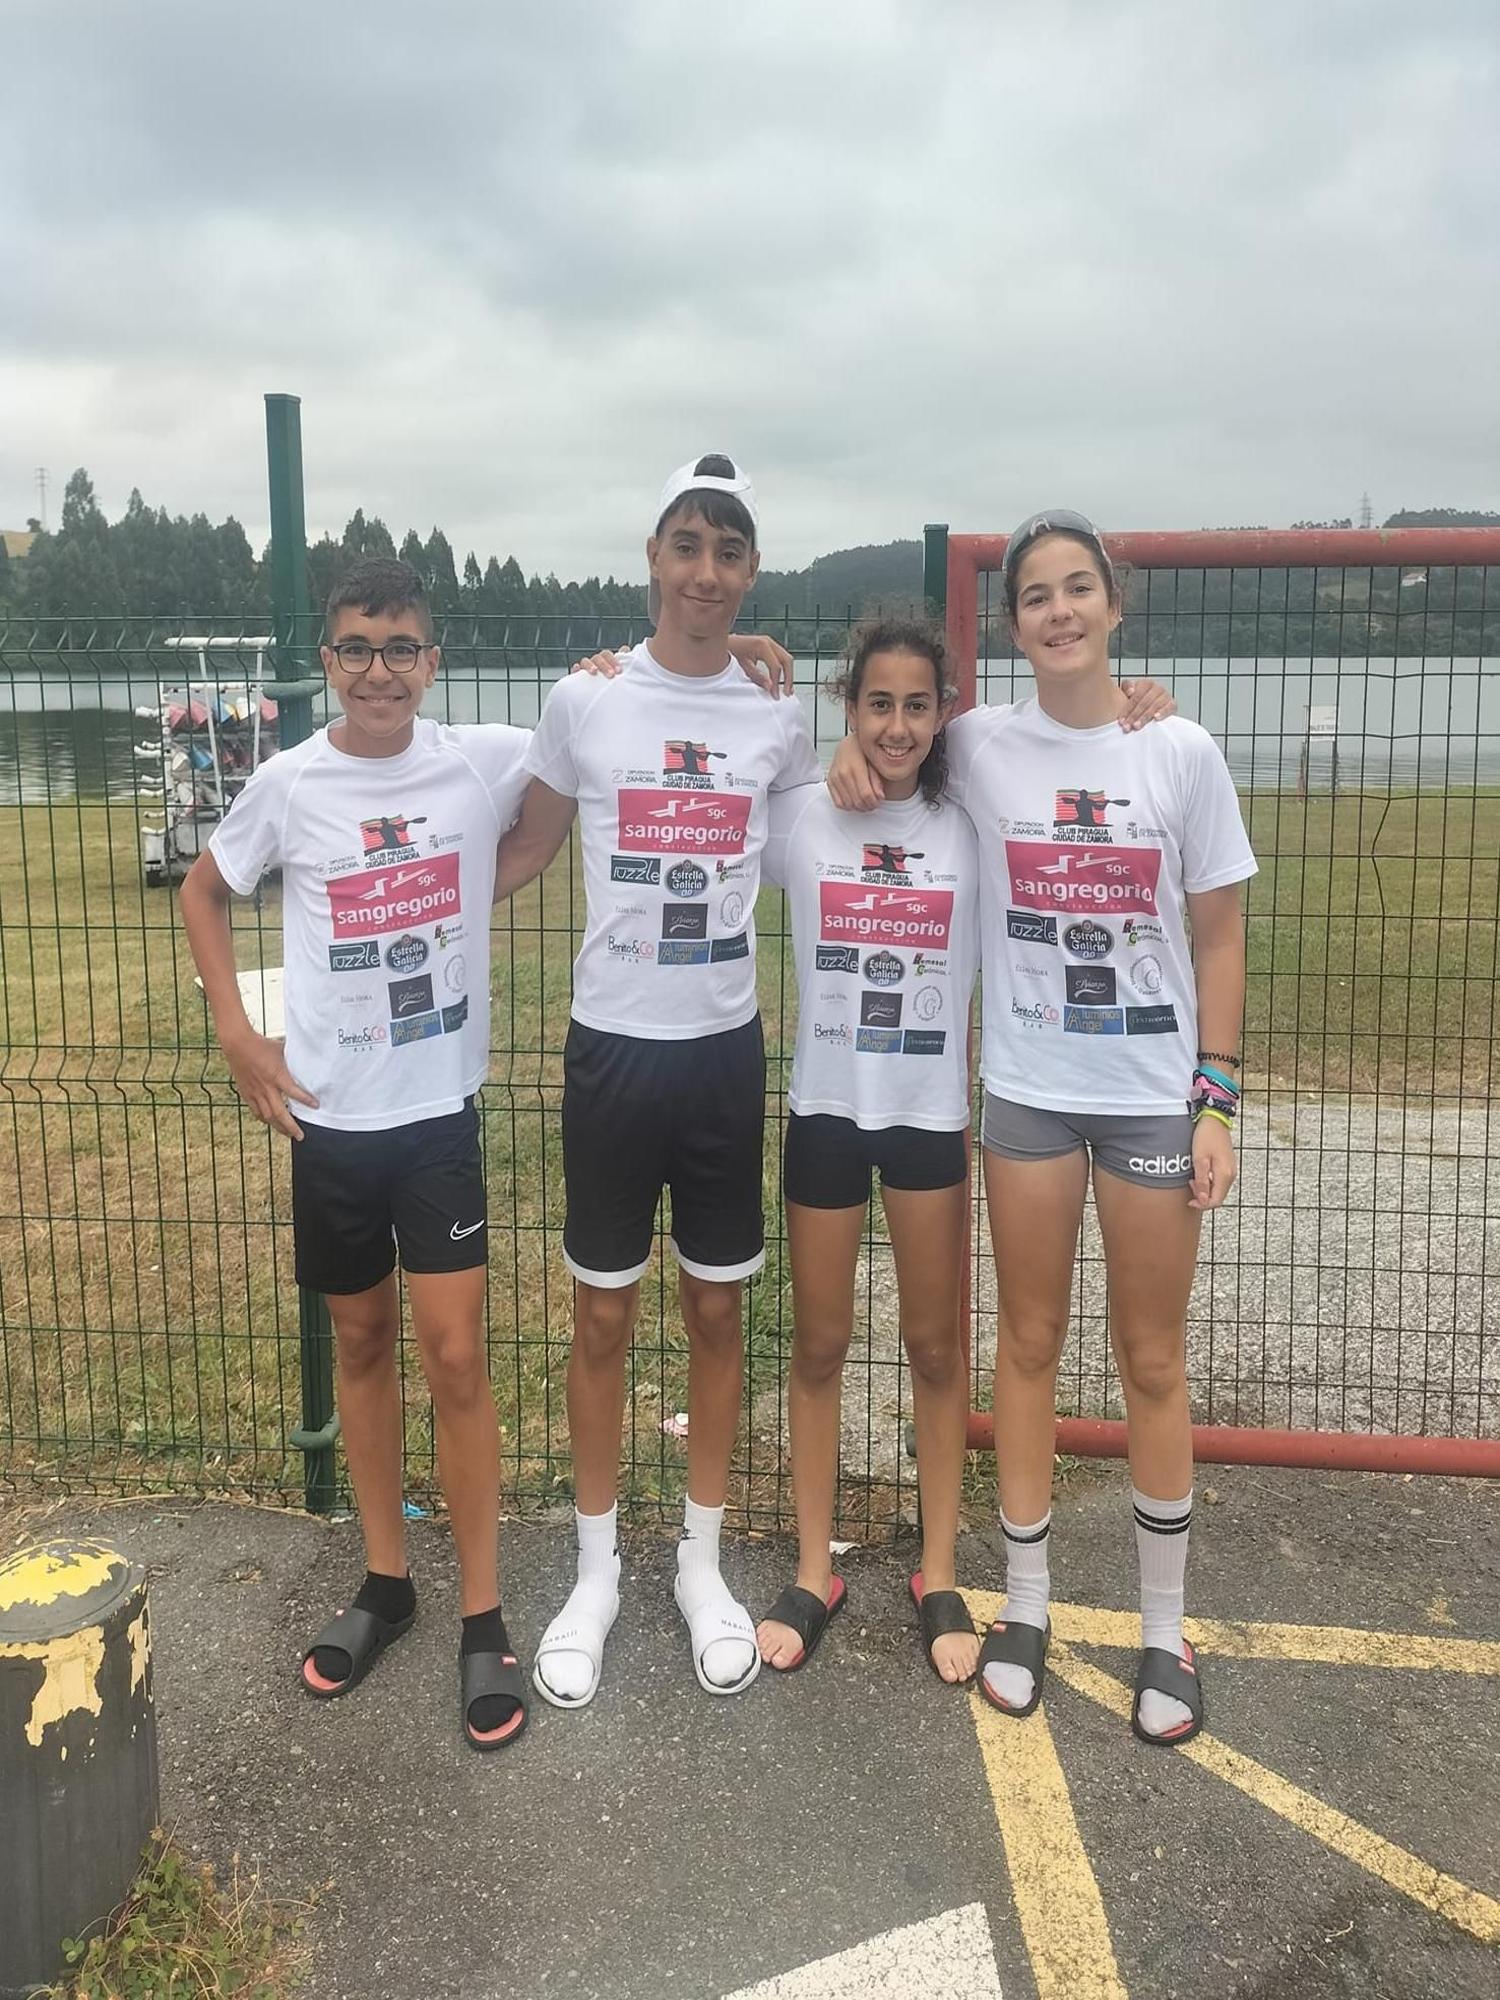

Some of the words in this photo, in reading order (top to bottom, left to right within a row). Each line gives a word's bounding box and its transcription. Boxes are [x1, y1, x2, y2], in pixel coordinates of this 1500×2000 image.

[625, 776, 658, 784] ZAMORA
[684, 775, 711, 783] PIRAGUA
[662, 781, 682, 789] CIUDAD
[692, 782, 715, 790] ZAMORA
[707, 807, 727, 819] sgc
[625, 823, 743, 845] sangregorio
[1011, 828, 1046, 836] ZAMORA
[1057, 827, 1077, 835] CLUB
[1078, 828, 1109, 836] PIRAGUA
[1052, 834, 1076, 842] CIUDAD
[1086, 836, 1113, 844] ZAMORA
[365, 859, 386, 868] CIUDAD
[397, 852, 420, 863] ZAMORA
[369, 852, 386, 861] CLUB
[387, 847, 415, 857] PIRAGUA
[612, 858, 660, 882] Puzzle
[671, 870, 704, 880] Estrella
[826, 870, 855, 878] ZAMORA
[1105, 864, 1130, 875] sgc
[417, 873, 437, 886] sgc
[672, 880, 702, 889] Galicia
[860, 876, 881, 884] CIUDAD
[890, 880, 913, 888] ZAMORA
[1015, 878, 1152, 903] sangregorio
[336, 887, 456, 925] sangregorio
[906, 903, 928, 915] sgc
[824, 915, 946, 937] sangregorio
[1008, 913, 1058, 944] Puzzle
[1122, 919, 1162, 933] Remesal
[1070, 929, 1107, 941] Estrella
[391, 943, 425, 958] Estrella
[1072, 940, 1106, 951] Galicia
[330, 944, 380, 969] Puzzle
[393, 953, 424, 967] Galicia
[817, 947, 859, 971] Puzzle
[869, 960, 901, 970] Estrella
[870, 970, 899, 979] Galicia
[1129, 1154, 1192, 1174] adida
